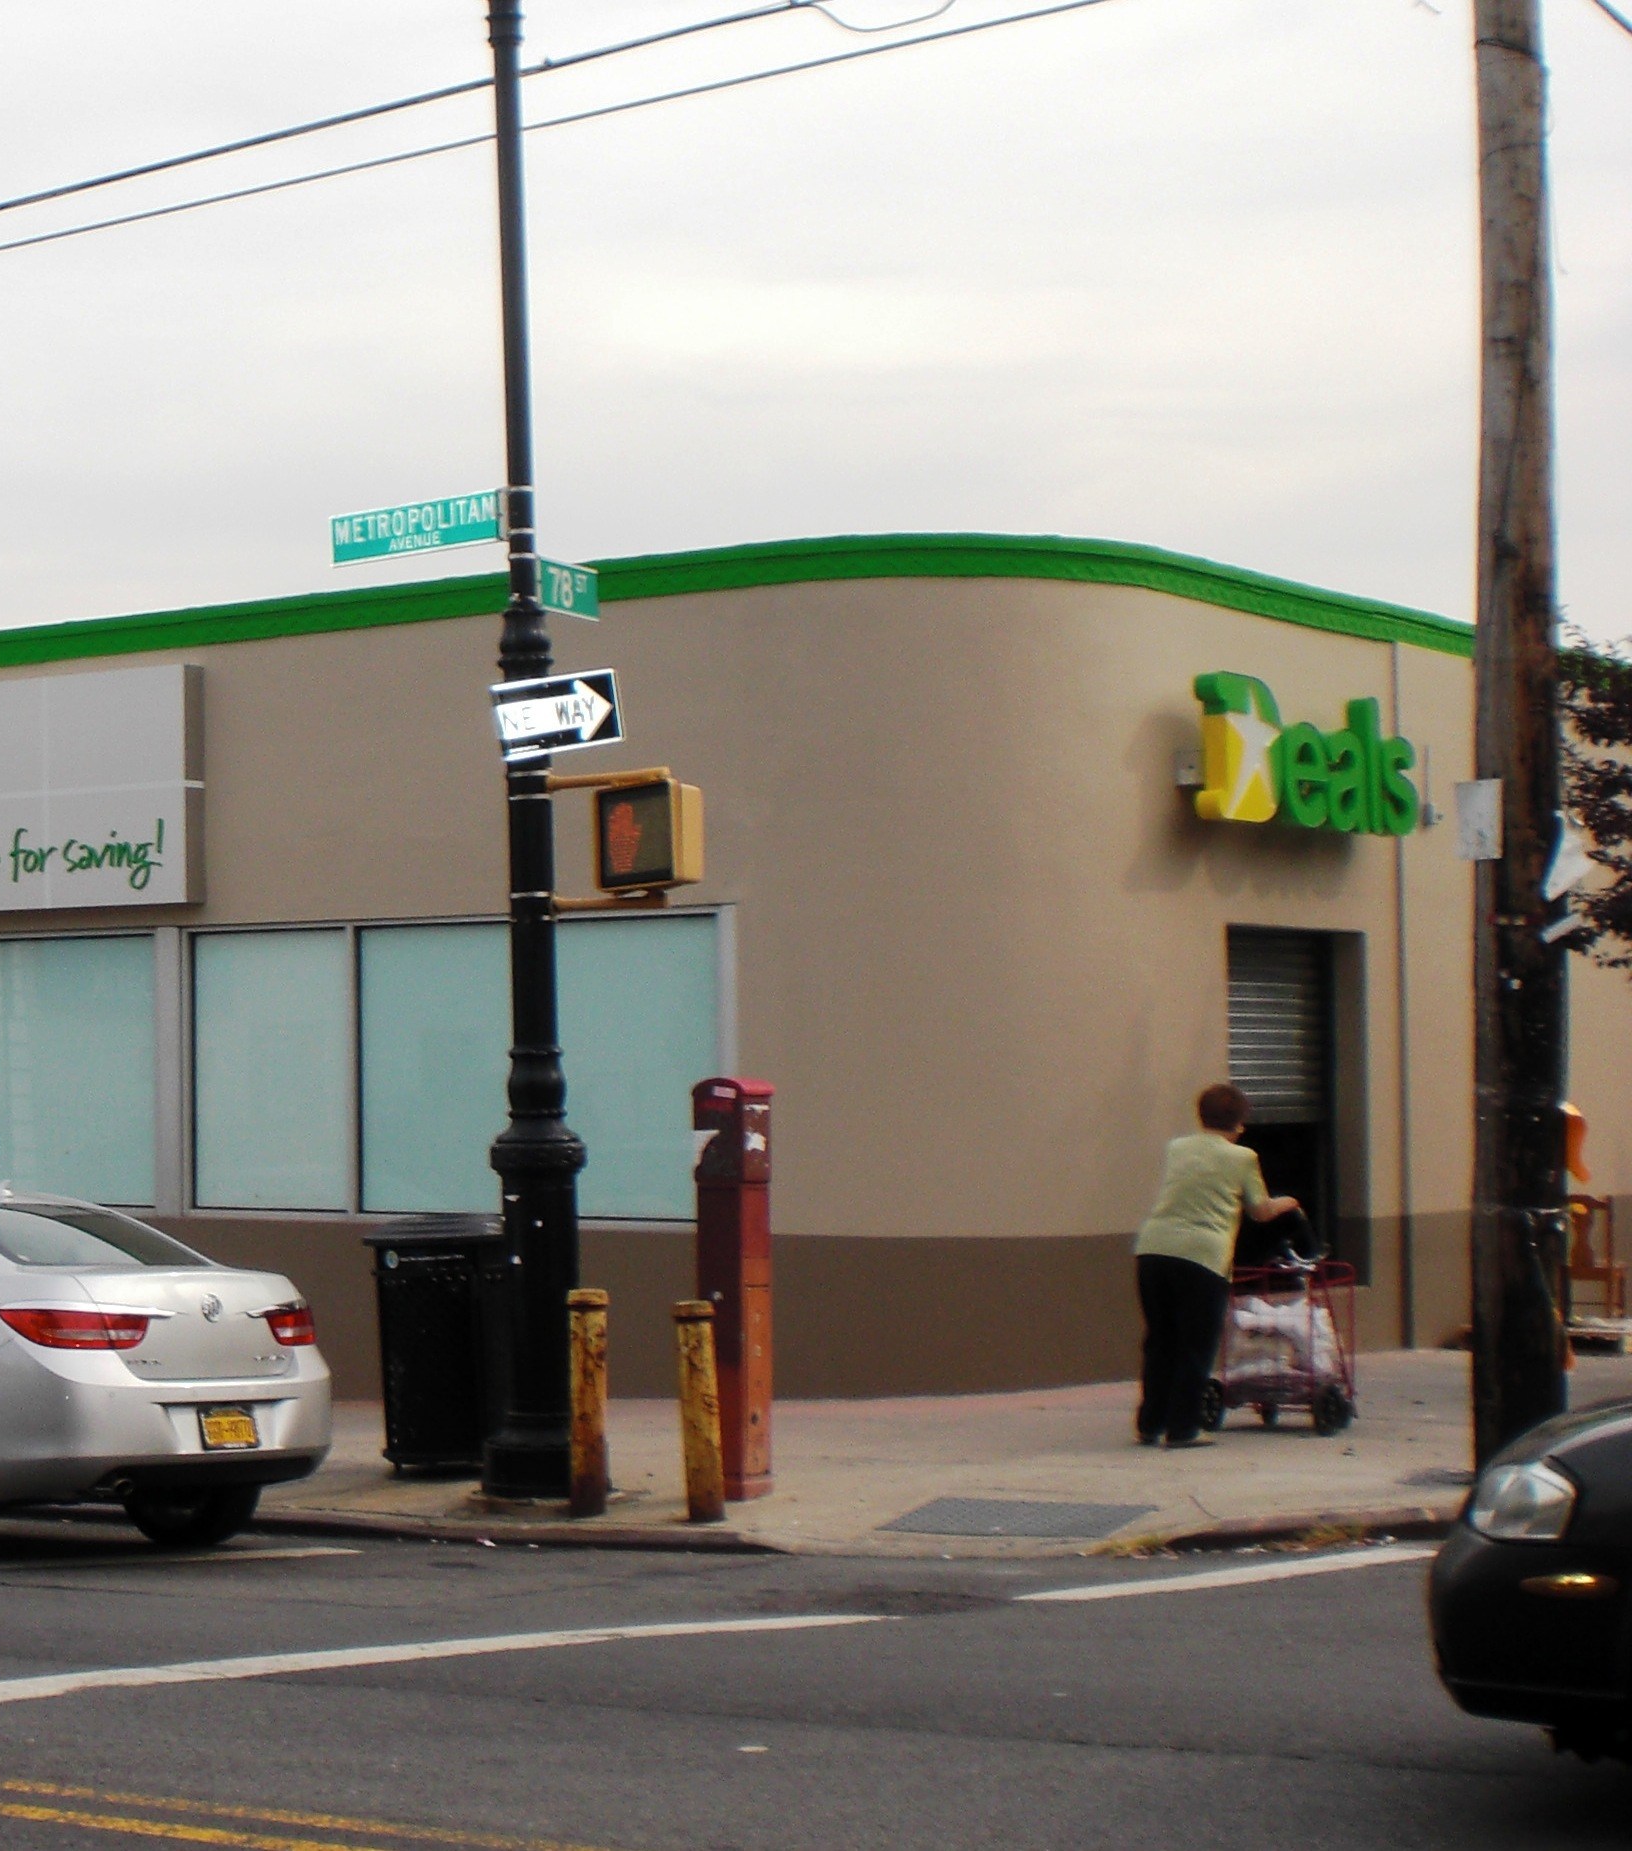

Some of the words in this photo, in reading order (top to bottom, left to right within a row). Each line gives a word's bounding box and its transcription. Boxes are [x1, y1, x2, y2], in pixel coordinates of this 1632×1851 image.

[334, 495, 497, 546] METROPOLITAN
[389, 531, 441, 551] AVENUE
[547, 567, 574, 608] 78
[575, 574, 588, 594] ST
[554, 695, 596, 726] WAY
[9, 828, 58, 883] for
